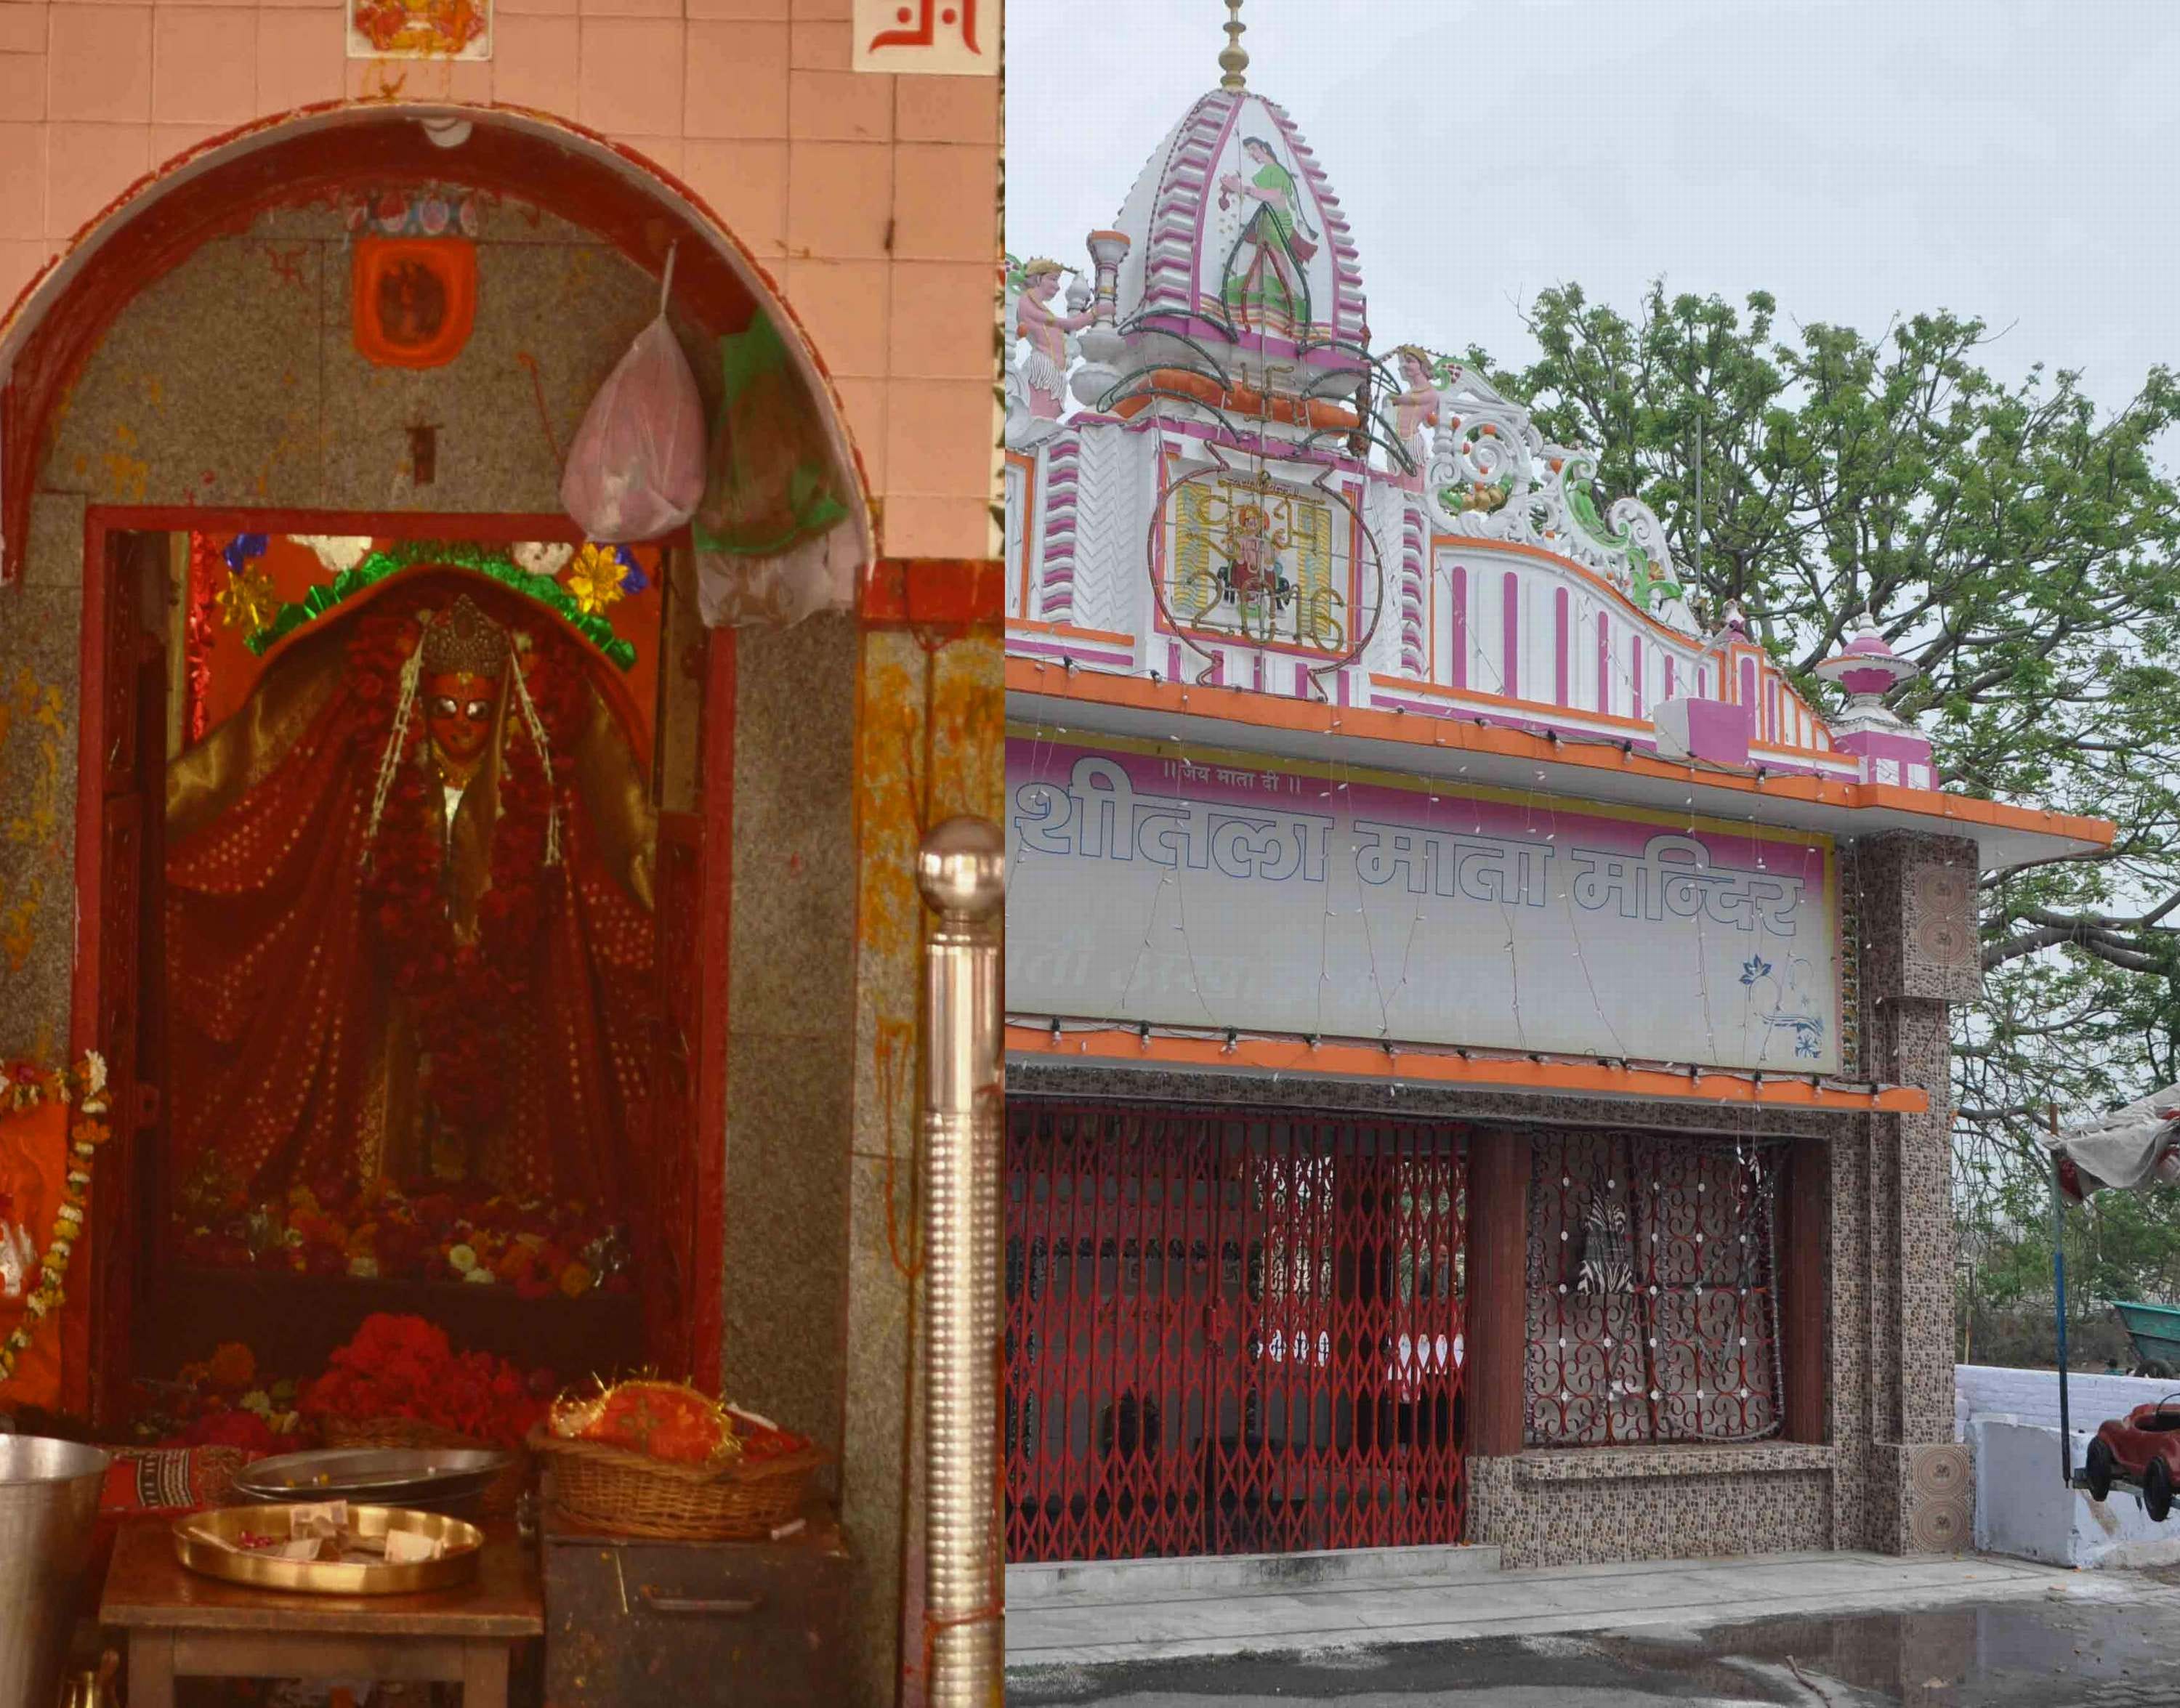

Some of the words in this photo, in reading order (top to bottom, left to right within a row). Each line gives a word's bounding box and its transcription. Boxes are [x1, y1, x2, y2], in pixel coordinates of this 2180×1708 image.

[1187, 570, 1344, 652] 2016
[1180, 764, 1211, 785] जय
[1216, 768, 1256, 790] माता
[1260, 770, 1280, 793] दी
[1014, 756, 1334, 882] शीतला
[1354, 819, 1555, 907] माता
[1570, 833, 1805, 936] मन्दिर
